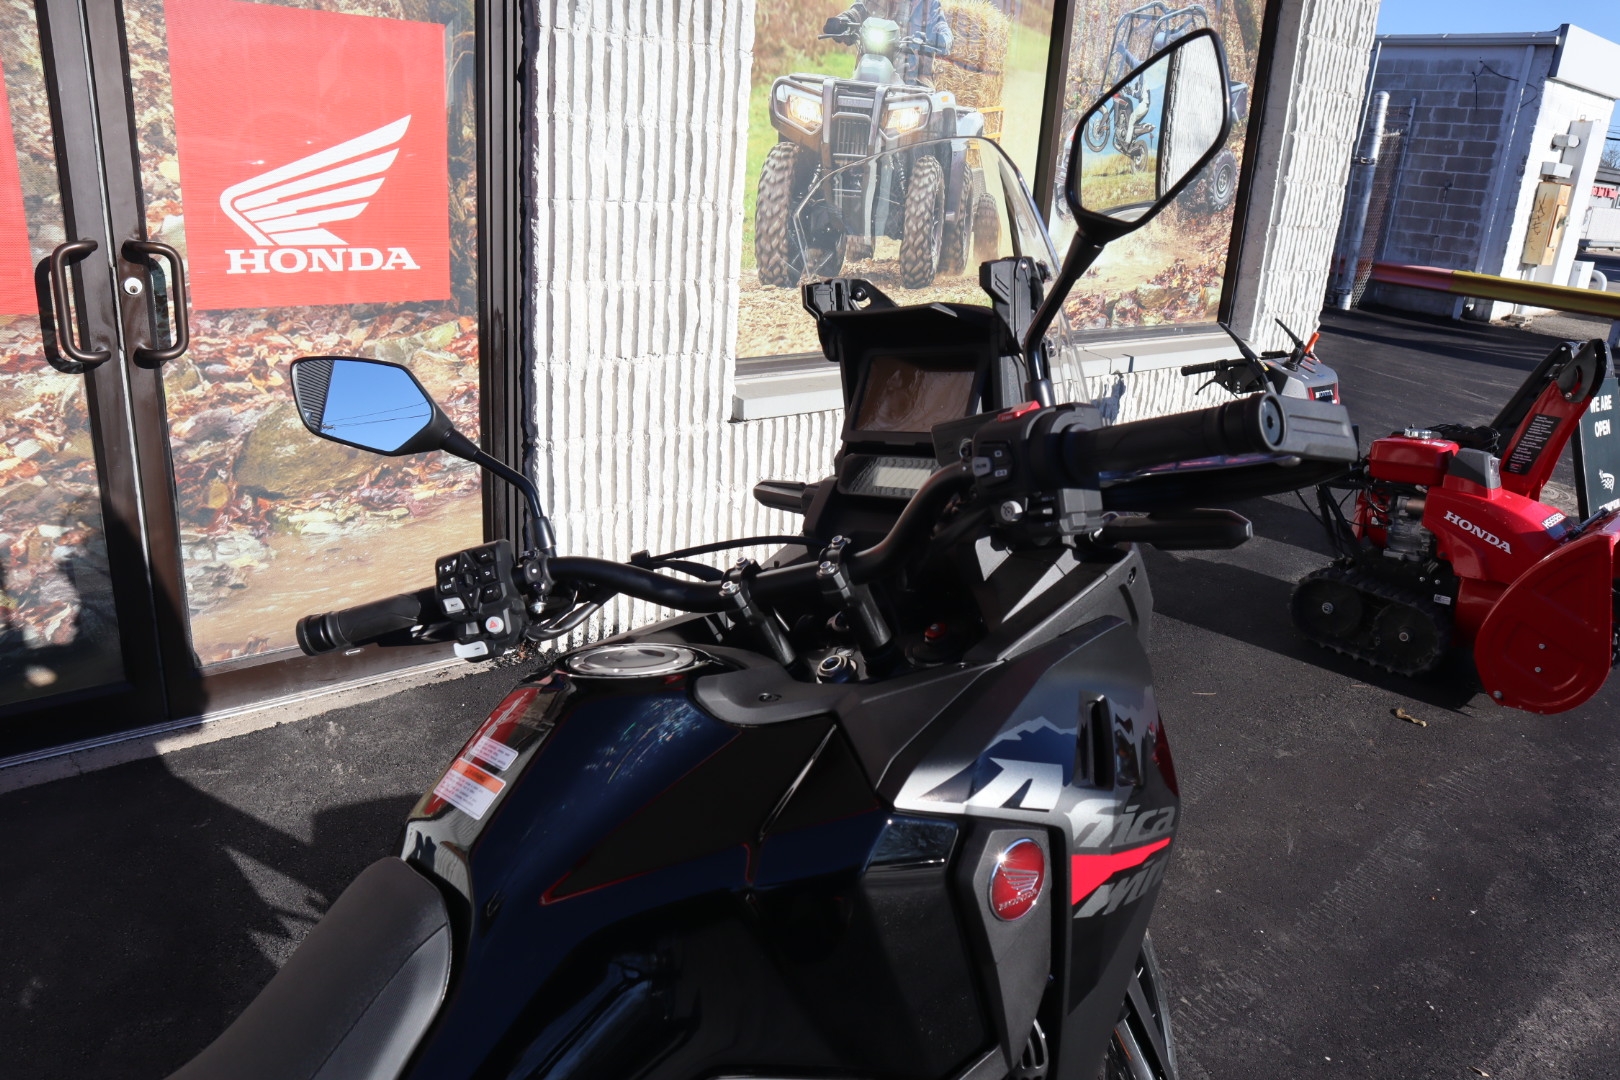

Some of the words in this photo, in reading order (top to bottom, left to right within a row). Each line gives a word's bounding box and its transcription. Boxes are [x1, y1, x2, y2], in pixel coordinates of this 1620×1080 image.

[224, 247, 421, 274] HONDA
[1590, 396, 1600, 413] WE
[1600, 394, 1612, 411] ARE
[1594, 418, 1611, 438] OPEN
[1443, 510, 1512, 554] HONDA
